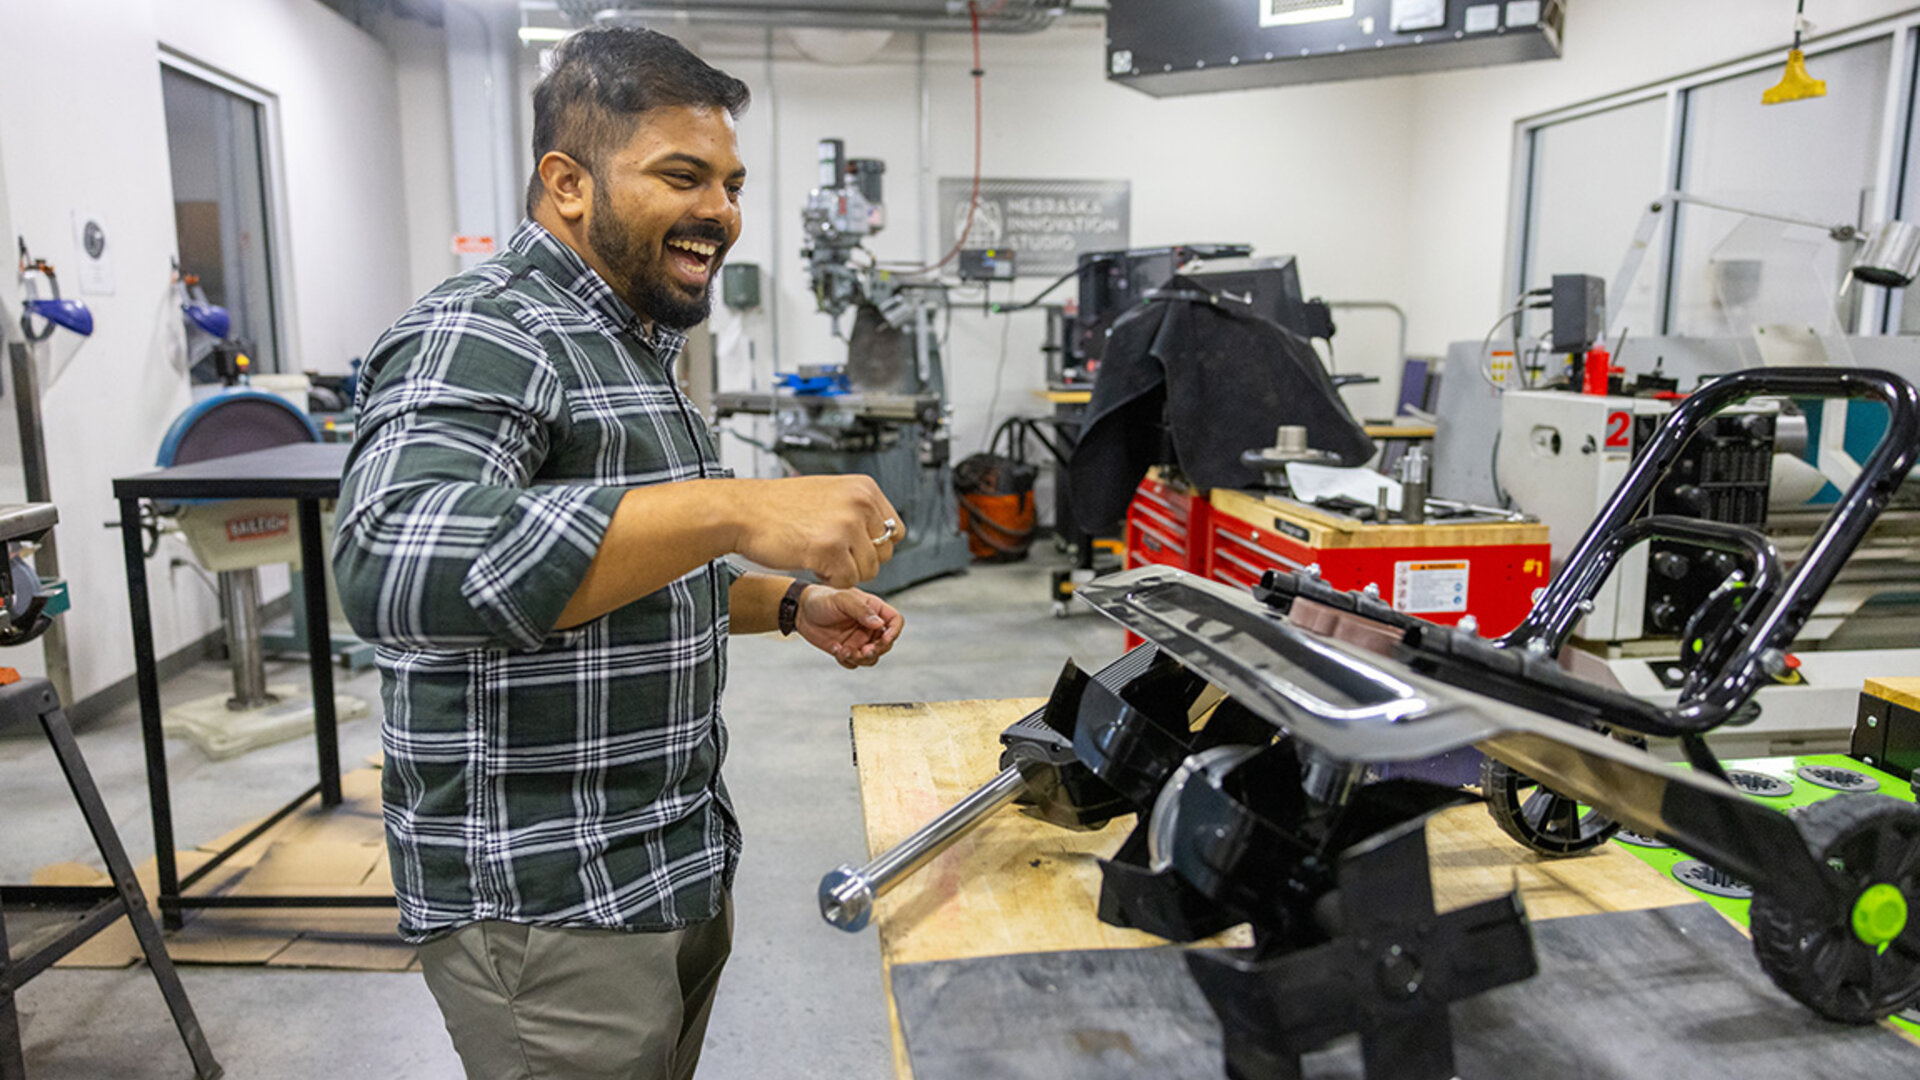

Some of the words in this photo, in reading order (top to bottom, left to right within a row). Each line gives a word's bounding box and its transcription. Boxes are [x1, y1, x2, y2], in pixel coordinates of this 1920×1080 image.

[1007, 198, 1103, 215] NEBRASKA
[1007, 216, 1120, 233] INNOVATION
[1007, 234, 1075, 251] STUDIO
[1605, 412, 1631, 446] 2
[1523, 558, 1543, 578] #1
